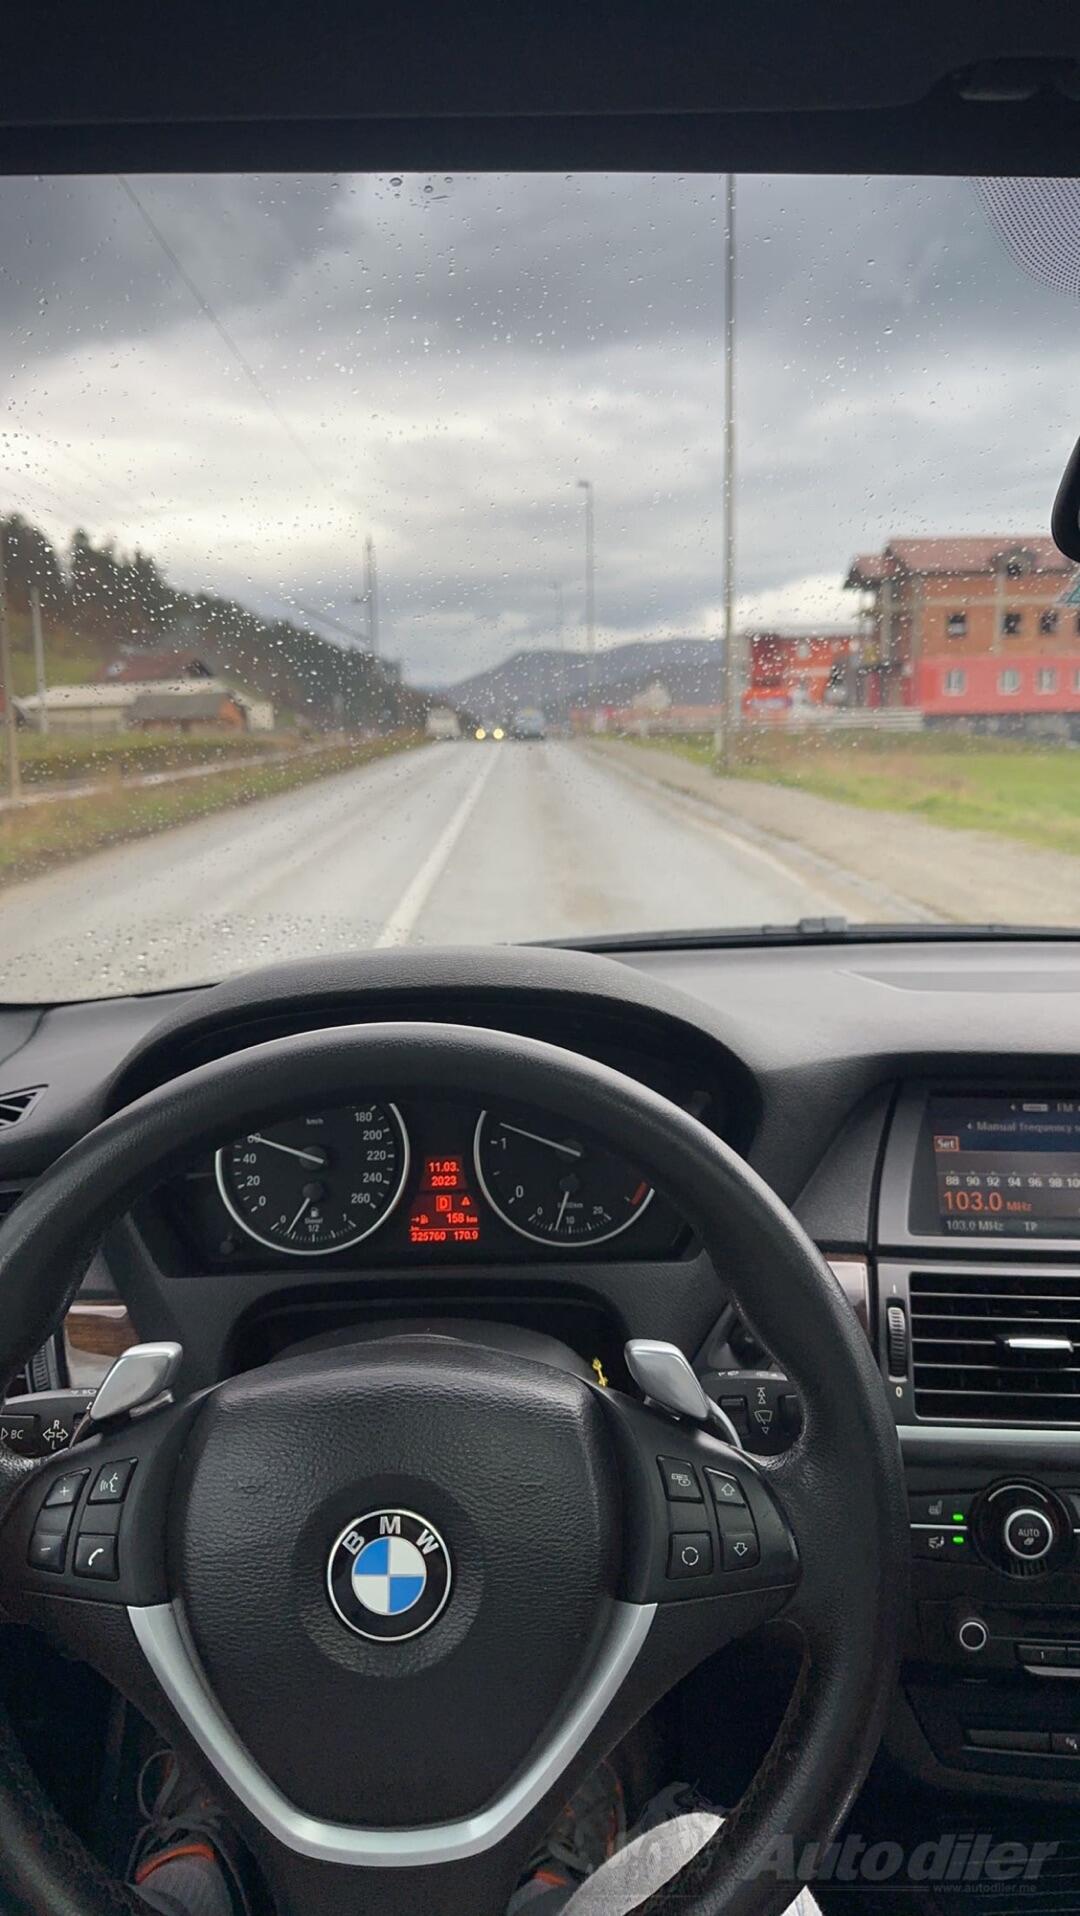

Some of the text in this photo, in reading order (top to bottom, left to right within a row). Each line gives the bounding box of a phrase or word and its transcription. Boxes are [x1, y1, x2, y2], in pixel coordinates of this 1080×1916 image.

[354, 1112, 372, 1122] 180
[976, 1121, 1016, 1131] Manual
[1019, 1121, 1072, 1133] frequency
[363, 1130, 383, 1140] 200
[500, 1137, 507, 1149] 1
[937, 1138, 955, 1149] Set
[242, 1153, 257, 1164] 40
[366, 1151, 386, 1161] 220
[429, 1162, 460, 1172] 11.03.
[246, 1176, 260, 1186] 20
[362, 1172, 383, 1183] 240
[431, 1175, 457, 1186] 2023
[945, 1176, 1080, 1188] 88 90 92 94 96 98 10
[515, 1185, 524, 1198] 0
[259, 1195, 266, 1206] 0
[351, 1193, 370, 1204] 260
[944, 1191, 1032, 1211] 103.0 MHz
[537, 1207, 543, 1215] 0
[592, 1206, 603, 1214] 20
[280, 1215, 286, 1224] 0
[566, 1216, 575, 1224] 10
[308, 1224, 320, 1232] 1/2
[946, 1221, 1038, 1232] 103.0 MHz TP
[411, 1230, 478, 1241] 325760 170.9
[53, 1420, 60, 1429] R
[10, 1429, 24, 1439] BC
[342, 1516, 440, 1555] BMW
[1018, 1528, 1040, 1537] AUTO
